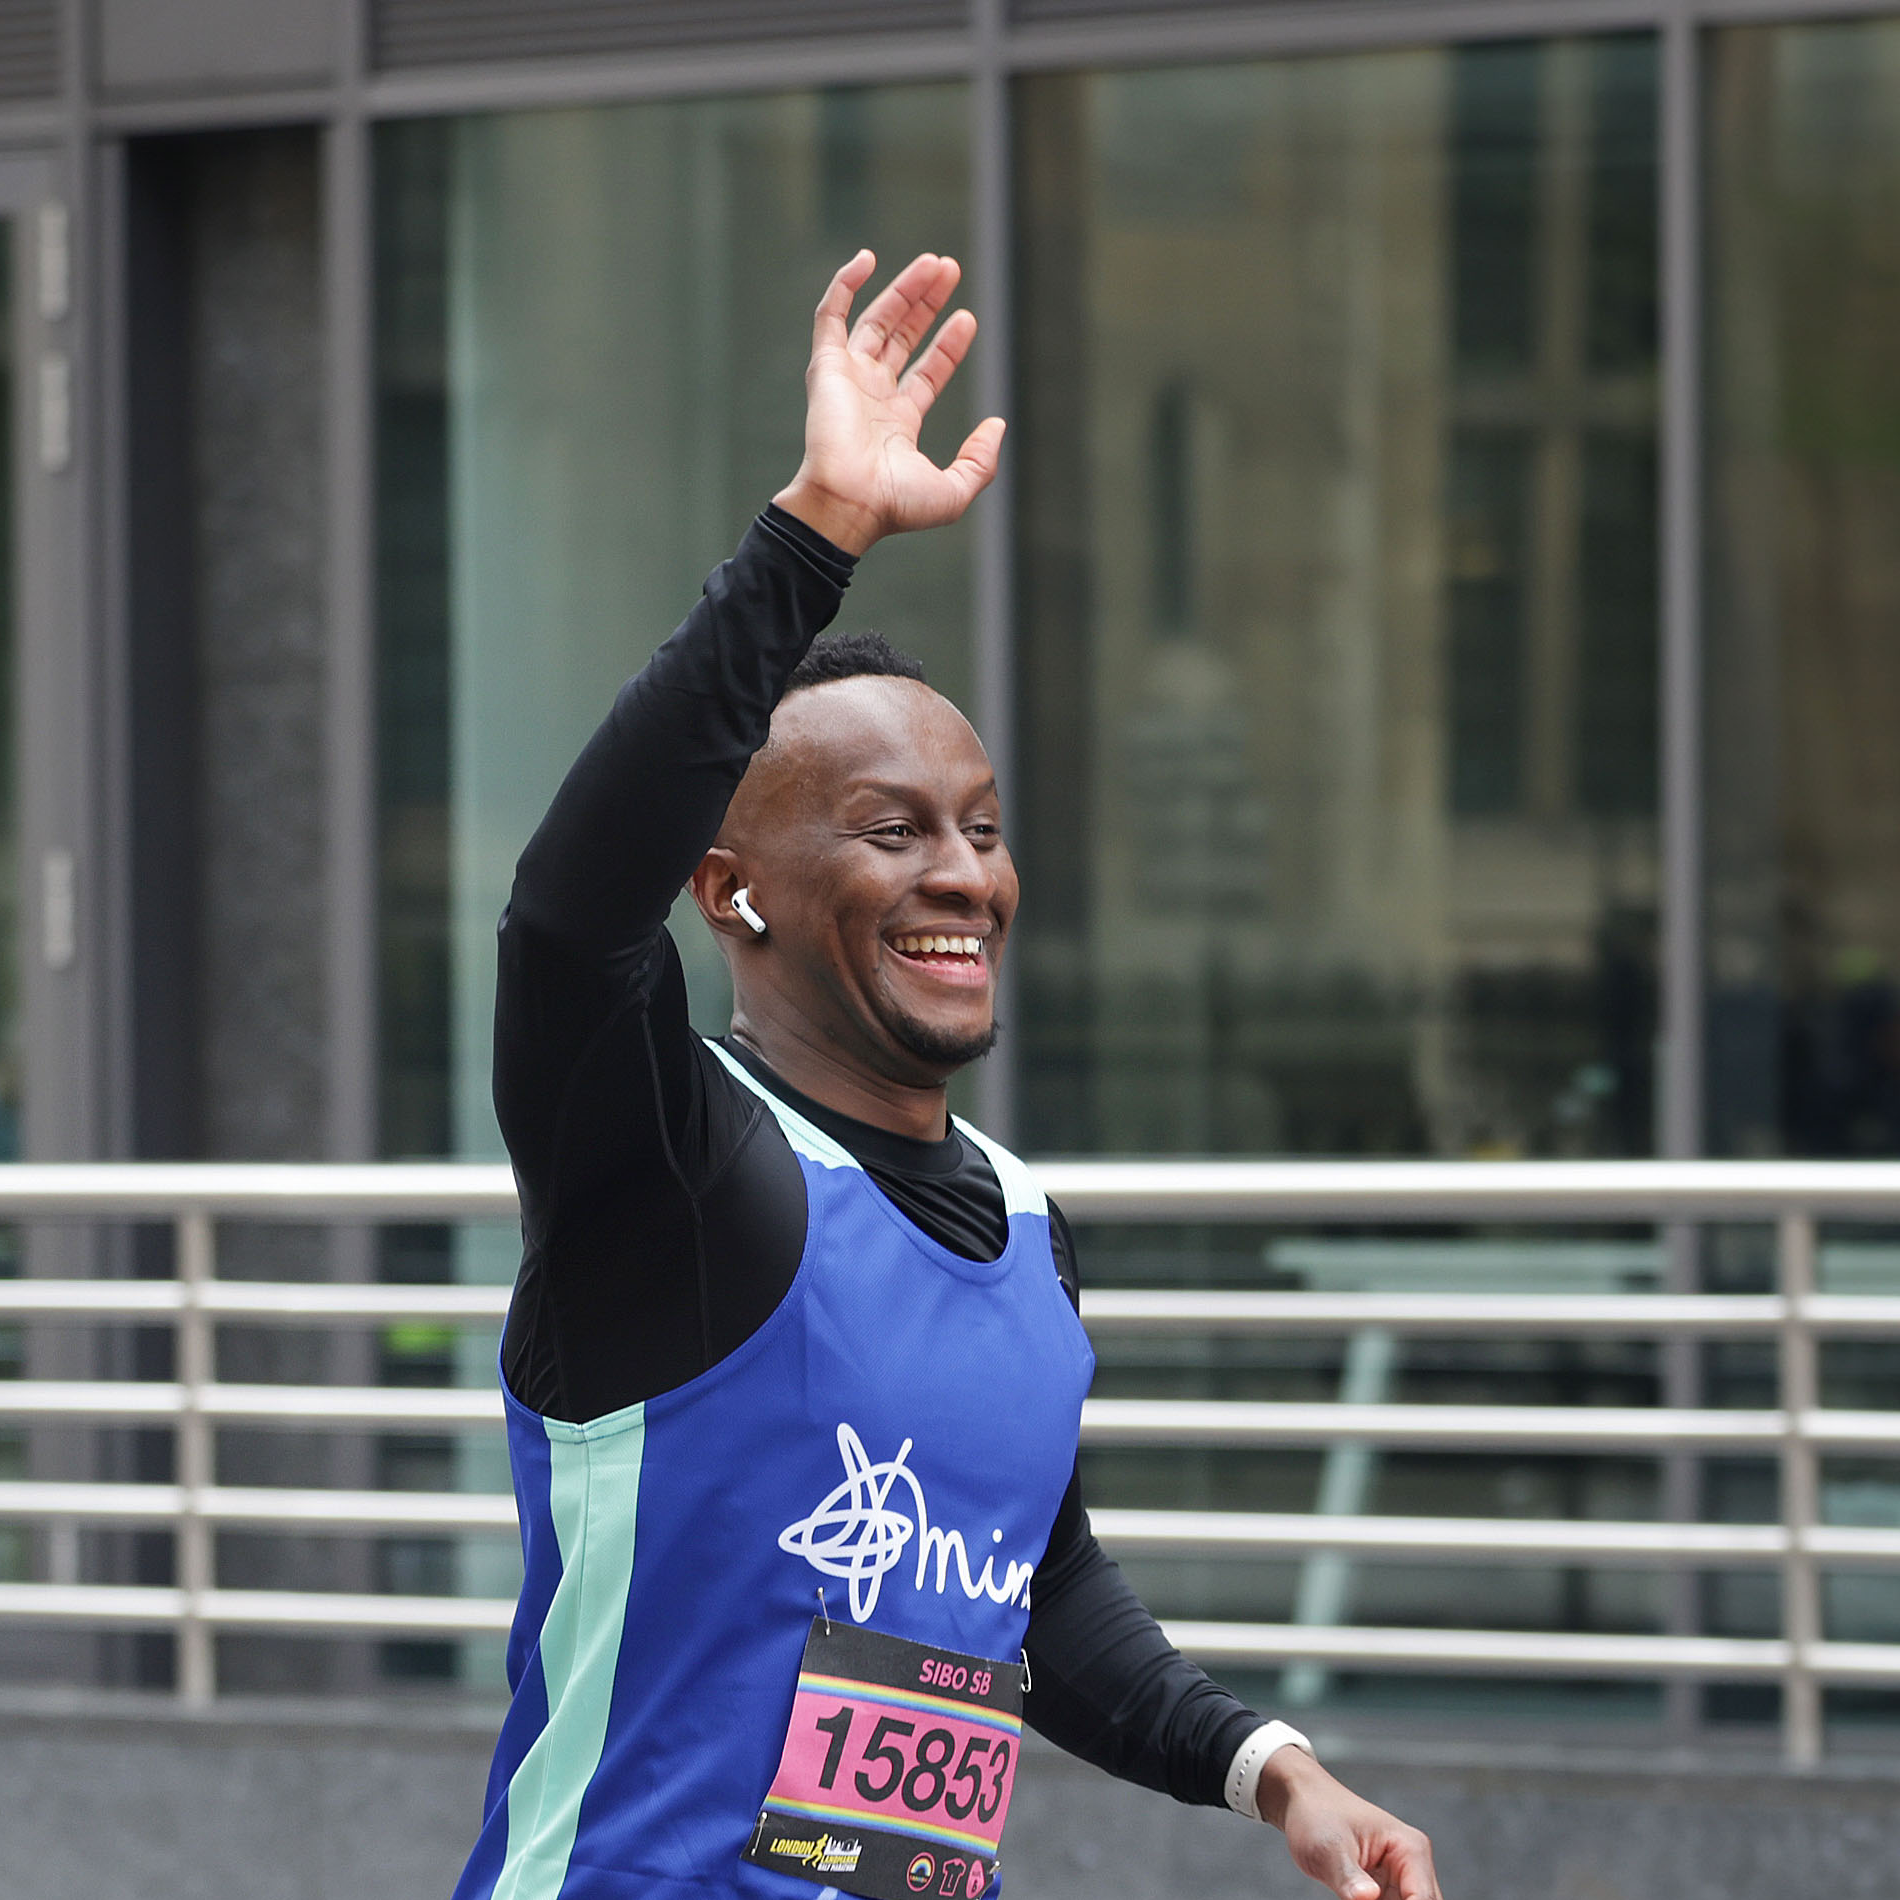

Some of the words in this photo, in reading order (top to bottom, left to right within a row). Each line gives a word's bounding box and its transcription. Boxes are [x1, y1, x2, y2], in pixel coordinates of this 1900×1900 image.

[918, 1658, 968, 1691] SIBO
[969, 1669, 992, 1696] SB
[815, 1705, 1011, 1823] 15853
[769, 1838, 816, 1855] LONDON
